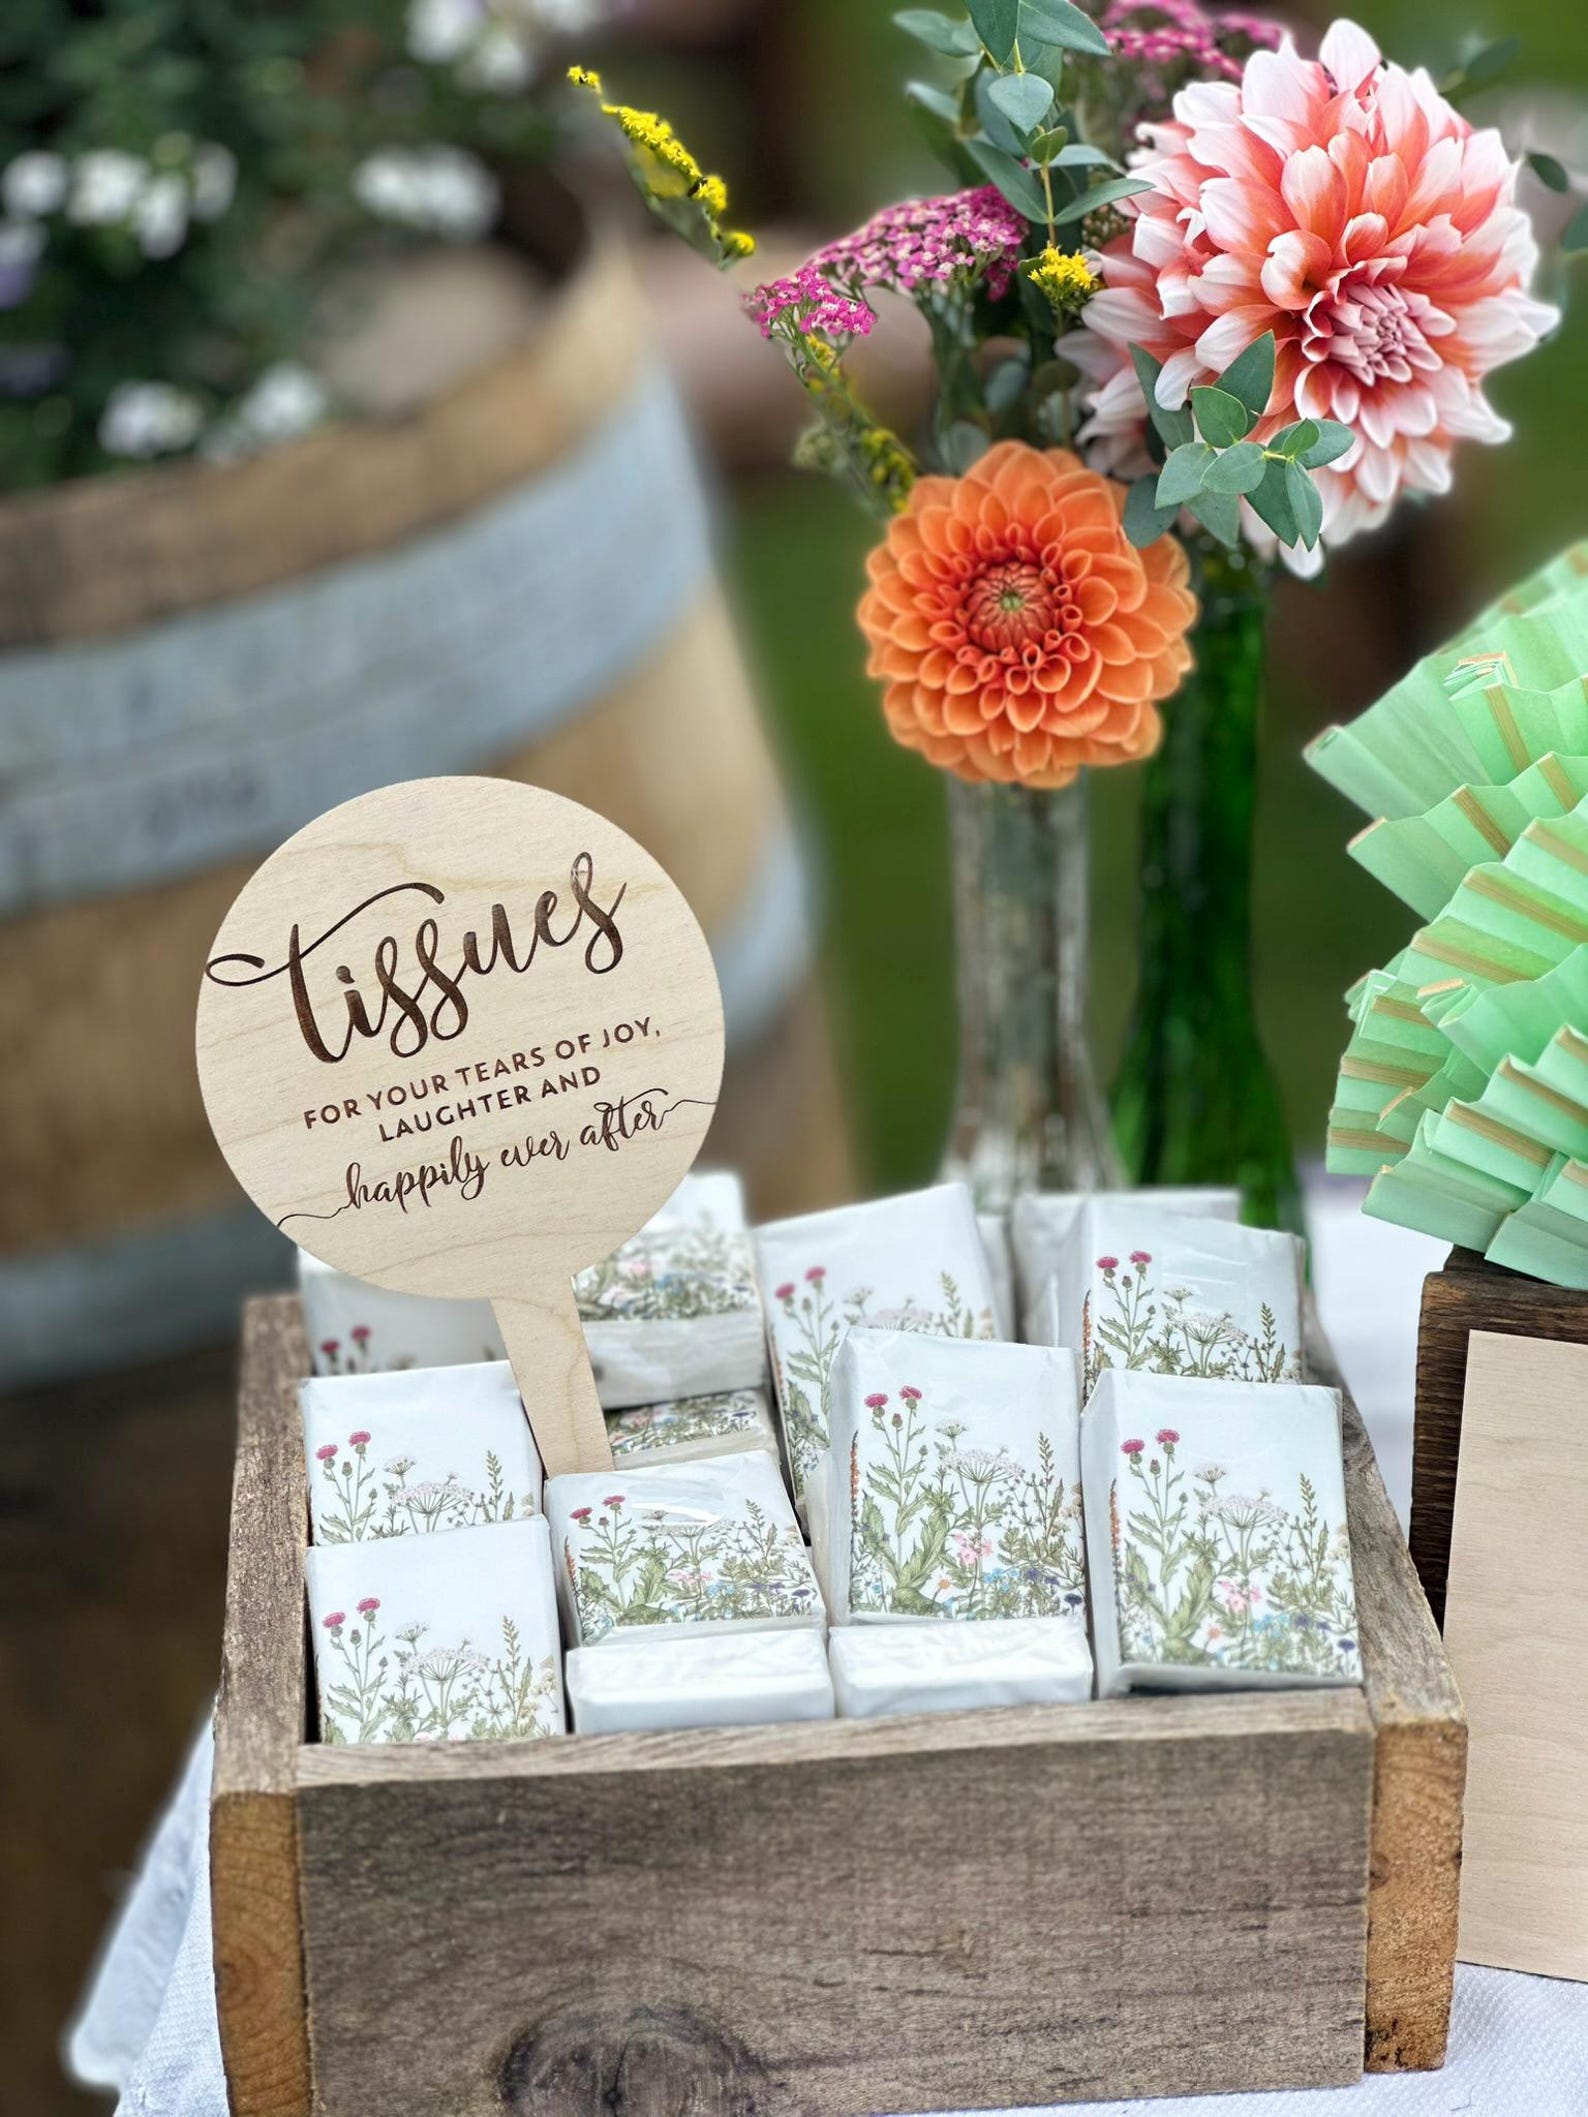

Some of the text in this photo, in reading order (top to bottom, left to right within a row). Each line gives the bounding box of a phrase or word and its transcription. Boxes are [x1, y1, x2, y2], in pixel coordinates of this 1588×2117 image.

[304, 1016, 661, 1129] FOR YOUR TEARS OF JOY,
[378, 1065, 602, 1142] LAUGHTER AND
[332, 1087, 676, 1213] happily ever after
